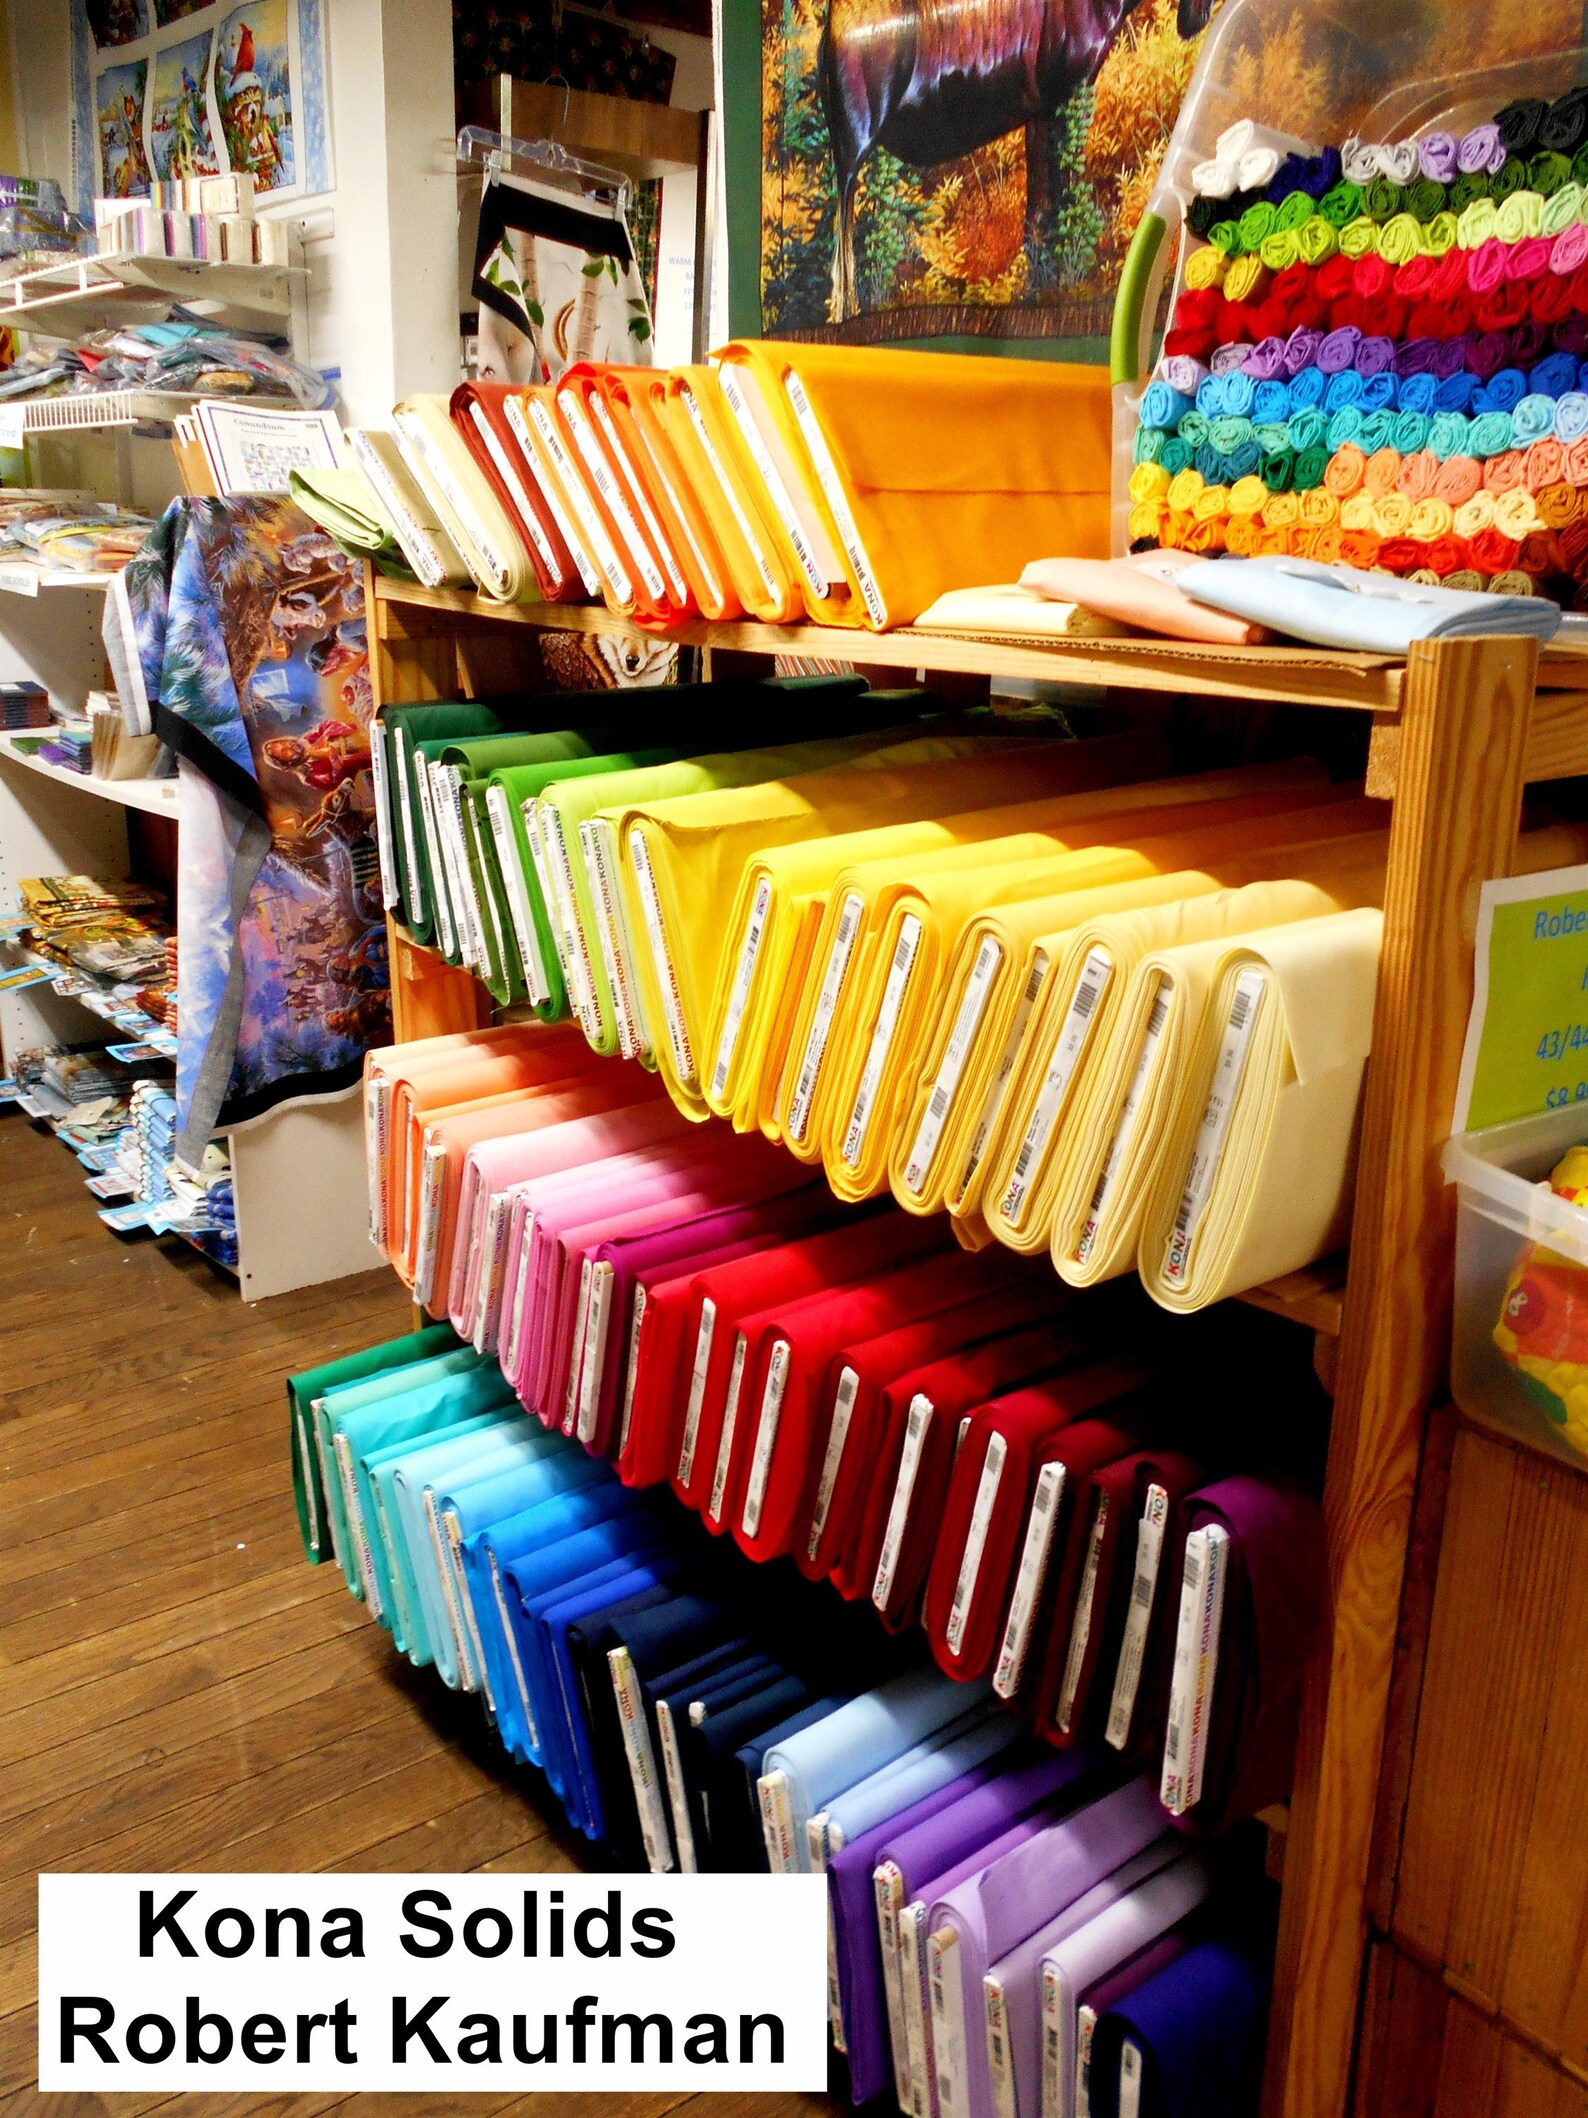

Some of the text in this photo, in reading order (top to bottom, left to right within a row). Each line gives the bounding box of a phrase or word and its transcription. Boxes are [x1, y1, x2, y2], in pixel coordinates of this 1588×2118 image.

[668, 256, 692, 266] WARM
[233, 418, 286, 432] Conundrum
[559, 398, 577, 431] KONA
[864, 583, 883, 625] KONA
[556, 824, 567, 856] KONA
[563, 858, 574, 890] KONA
[595, 845, 606, 879] KONA
[571, 892, 582, 927] KONA
[601, 880, 612, 914] KONA
[608, 915, 619, 949] KONA
[1534, 904, 1588, 940] Robe
[578, 927, 589, 959] KONA
[585, 961, 598, 995] KONA
[614, 950, 625, 984] KONA
[668, 964, 678, 999] KONA
[592, 995, 602, 1028] KONA
[620, 985, 632, 1019] KONA
[675, 1000, 687, 1036] KONA
[683, 1037, 694, 1072] KONA
[844, 1126, 859, 1163] KONA
[431, 1184, 440, 1208] KONA
[1000, 1181, 1020, 1217] KONA
[1073, 1220, 1096, 1262] KONA
[364, 1547, 373, 1575] KONA
[619, 1688, 634, 1720] KONA
